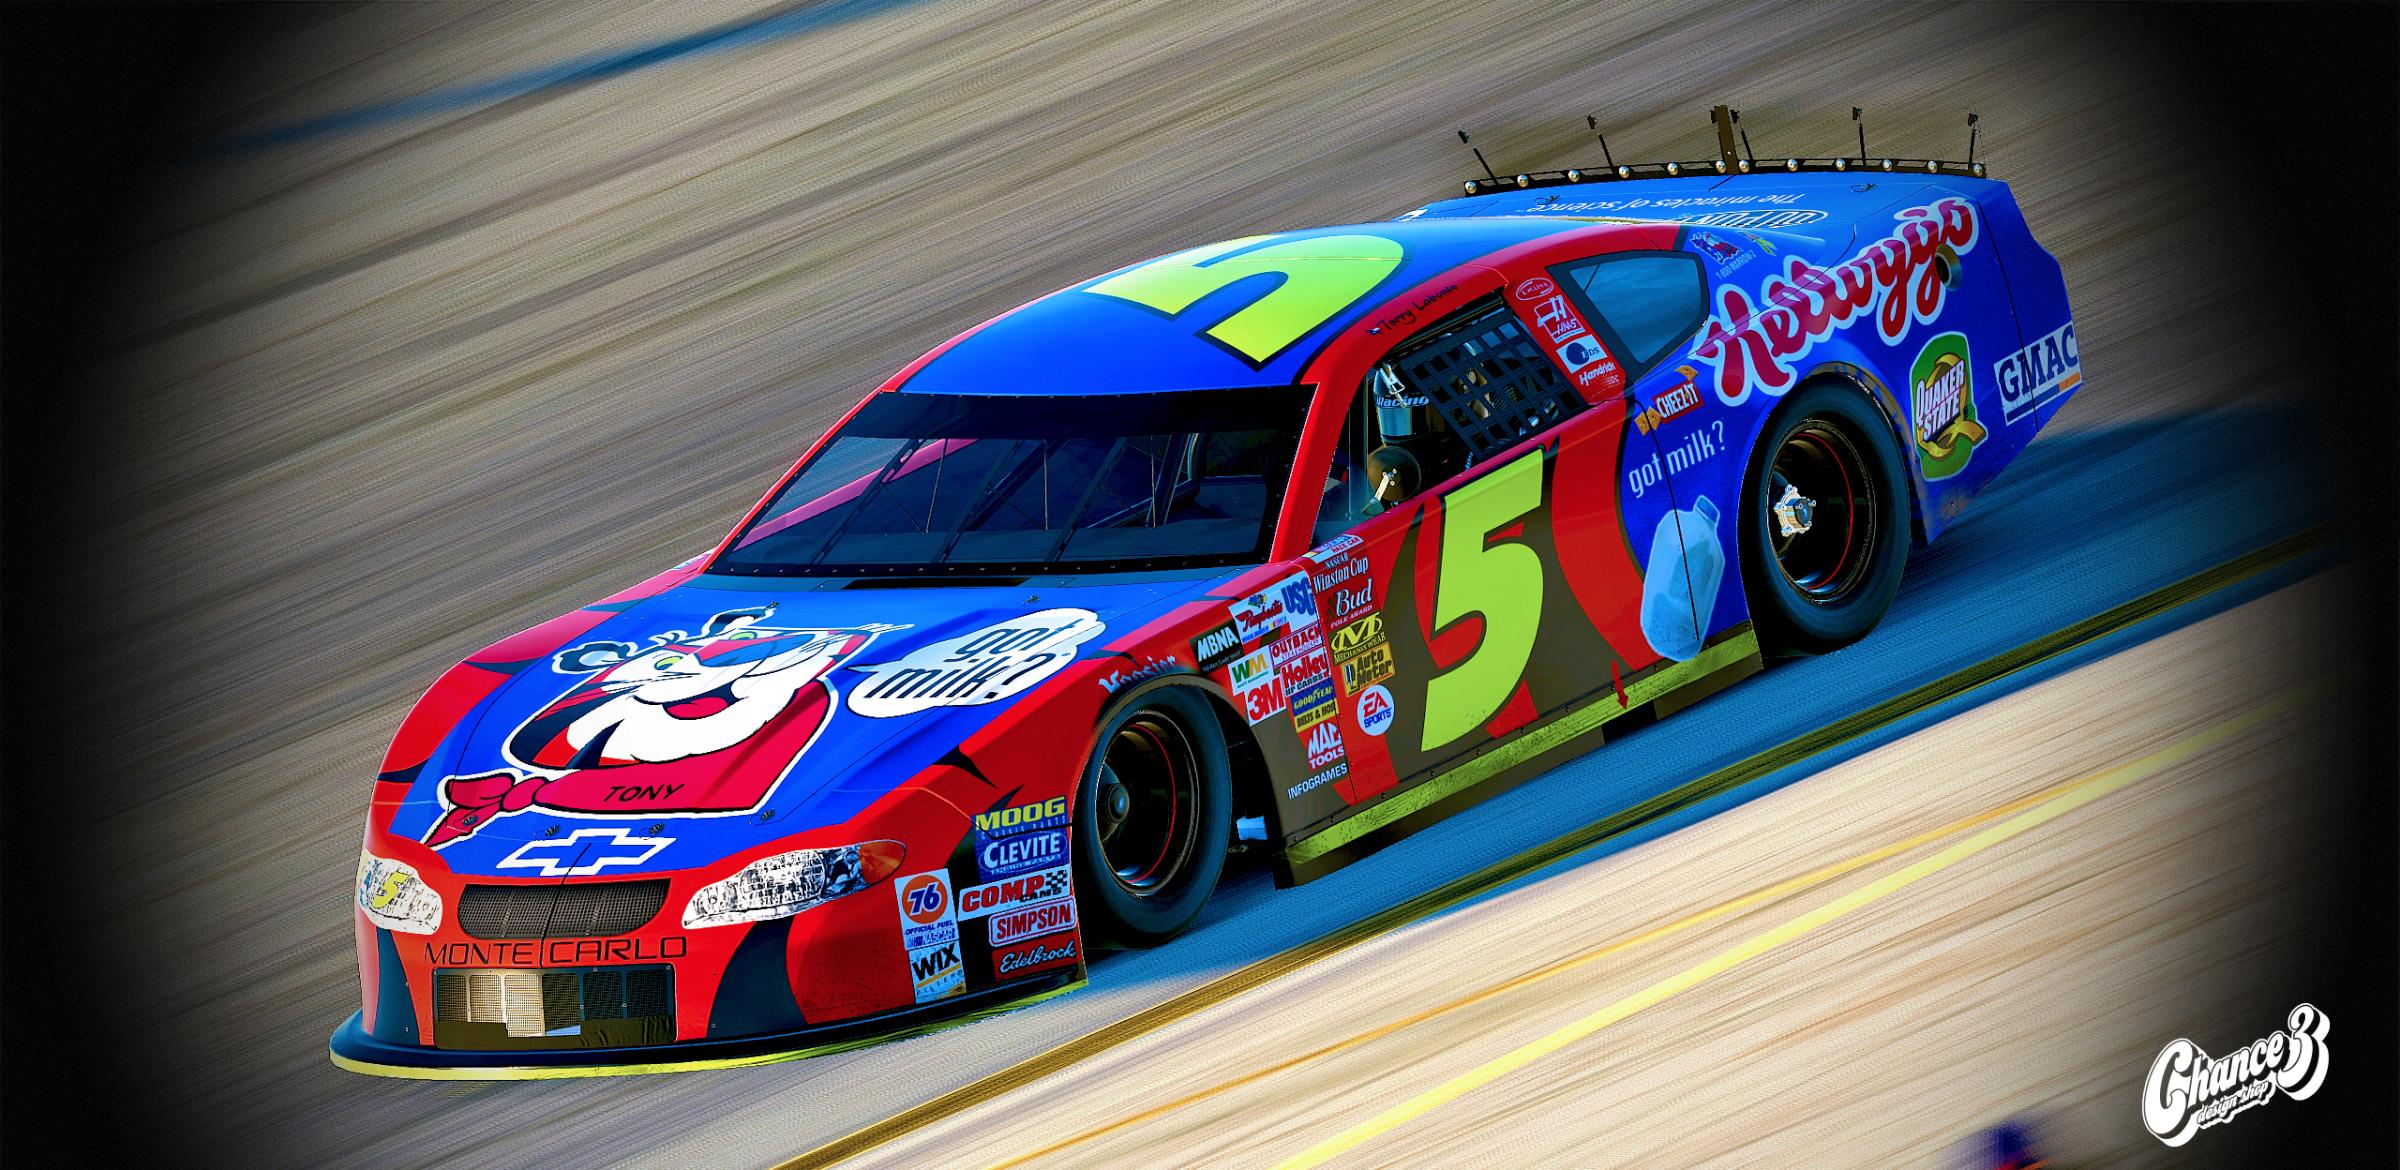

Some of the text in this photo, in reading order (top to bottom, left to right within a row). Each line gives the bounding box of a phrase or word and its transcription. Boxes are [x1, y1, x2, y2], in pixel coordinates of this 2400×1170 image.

[1611, 198, 1650, 211] of
[1650, 195, 1758, 209] miracles
[1758, 193, 1805, 204] The
[1080, 235, 1405, 364] 5
[1375, 309, 1417, 330] Terry
[1581, 346, 1601, 359] EDS
[1999, 325, 2078, 403] GMAC
[1578, 361, 1616, 386] Hendrick
[1915, 359, 1965, 428] QUAKER
[1922, 388, 1961, 442] STATE
[1628, 420, 1726, 499] got milk?
[1313, 556, 1369, 595] Winston Cup
[1324, 552, 1349, 570] NASCAR
[1281, 577, 1316, 616] USG
[1336, 578, 1373, 618] Bud
[1421, 448, 1544, 753] 5
[943, 618, 1085, 663] got
[1197, 626, 1240, 662] MBNA
[1272, 626, 1321, 658] OUTBACK
[863, 652, 1056, 699] milk?
[1231, 653, 1268, 683] WM
[1281, 654, 1329, 688] Holley
[1357, 649, 1385, 670] Auto
[1357, 659, 1393, 685] Meter
[1247, 677, 1285, 721] 3M
[1285, 686, 1297, 696] HP
[1293, 685, 1334, 710] GOODYEAR
[1363, 690, 1389, 718] EA
[1364, 707, 1392, 728] SPORTS
[1307, 722, 1343, 759] MAC
[1309, 745, 1345, 769] TOOLS
[603, 784, 685, 802] TONY
[1287, 762, 1348, 800] INFOGRAMES
[976, 796, 1065, 831] MOOG
[983, 832, 1061, 869] CLEVITE
[370, 870, 411, 910] 5
[907, 881, 942, 917] 76
[962, 874, 1045, 913] COMP
[1019, 886, 1063, 903] CAMS
[905, 919, 954, 936] OFFICIAL FUEL
[996, 903, 1072, 940] SIMPSON
[425, 936, 687, 965] MONTE CARLO
[912, 943, 961, 981] WIX
[1000, 940, 1077, 974] Edelbrock
